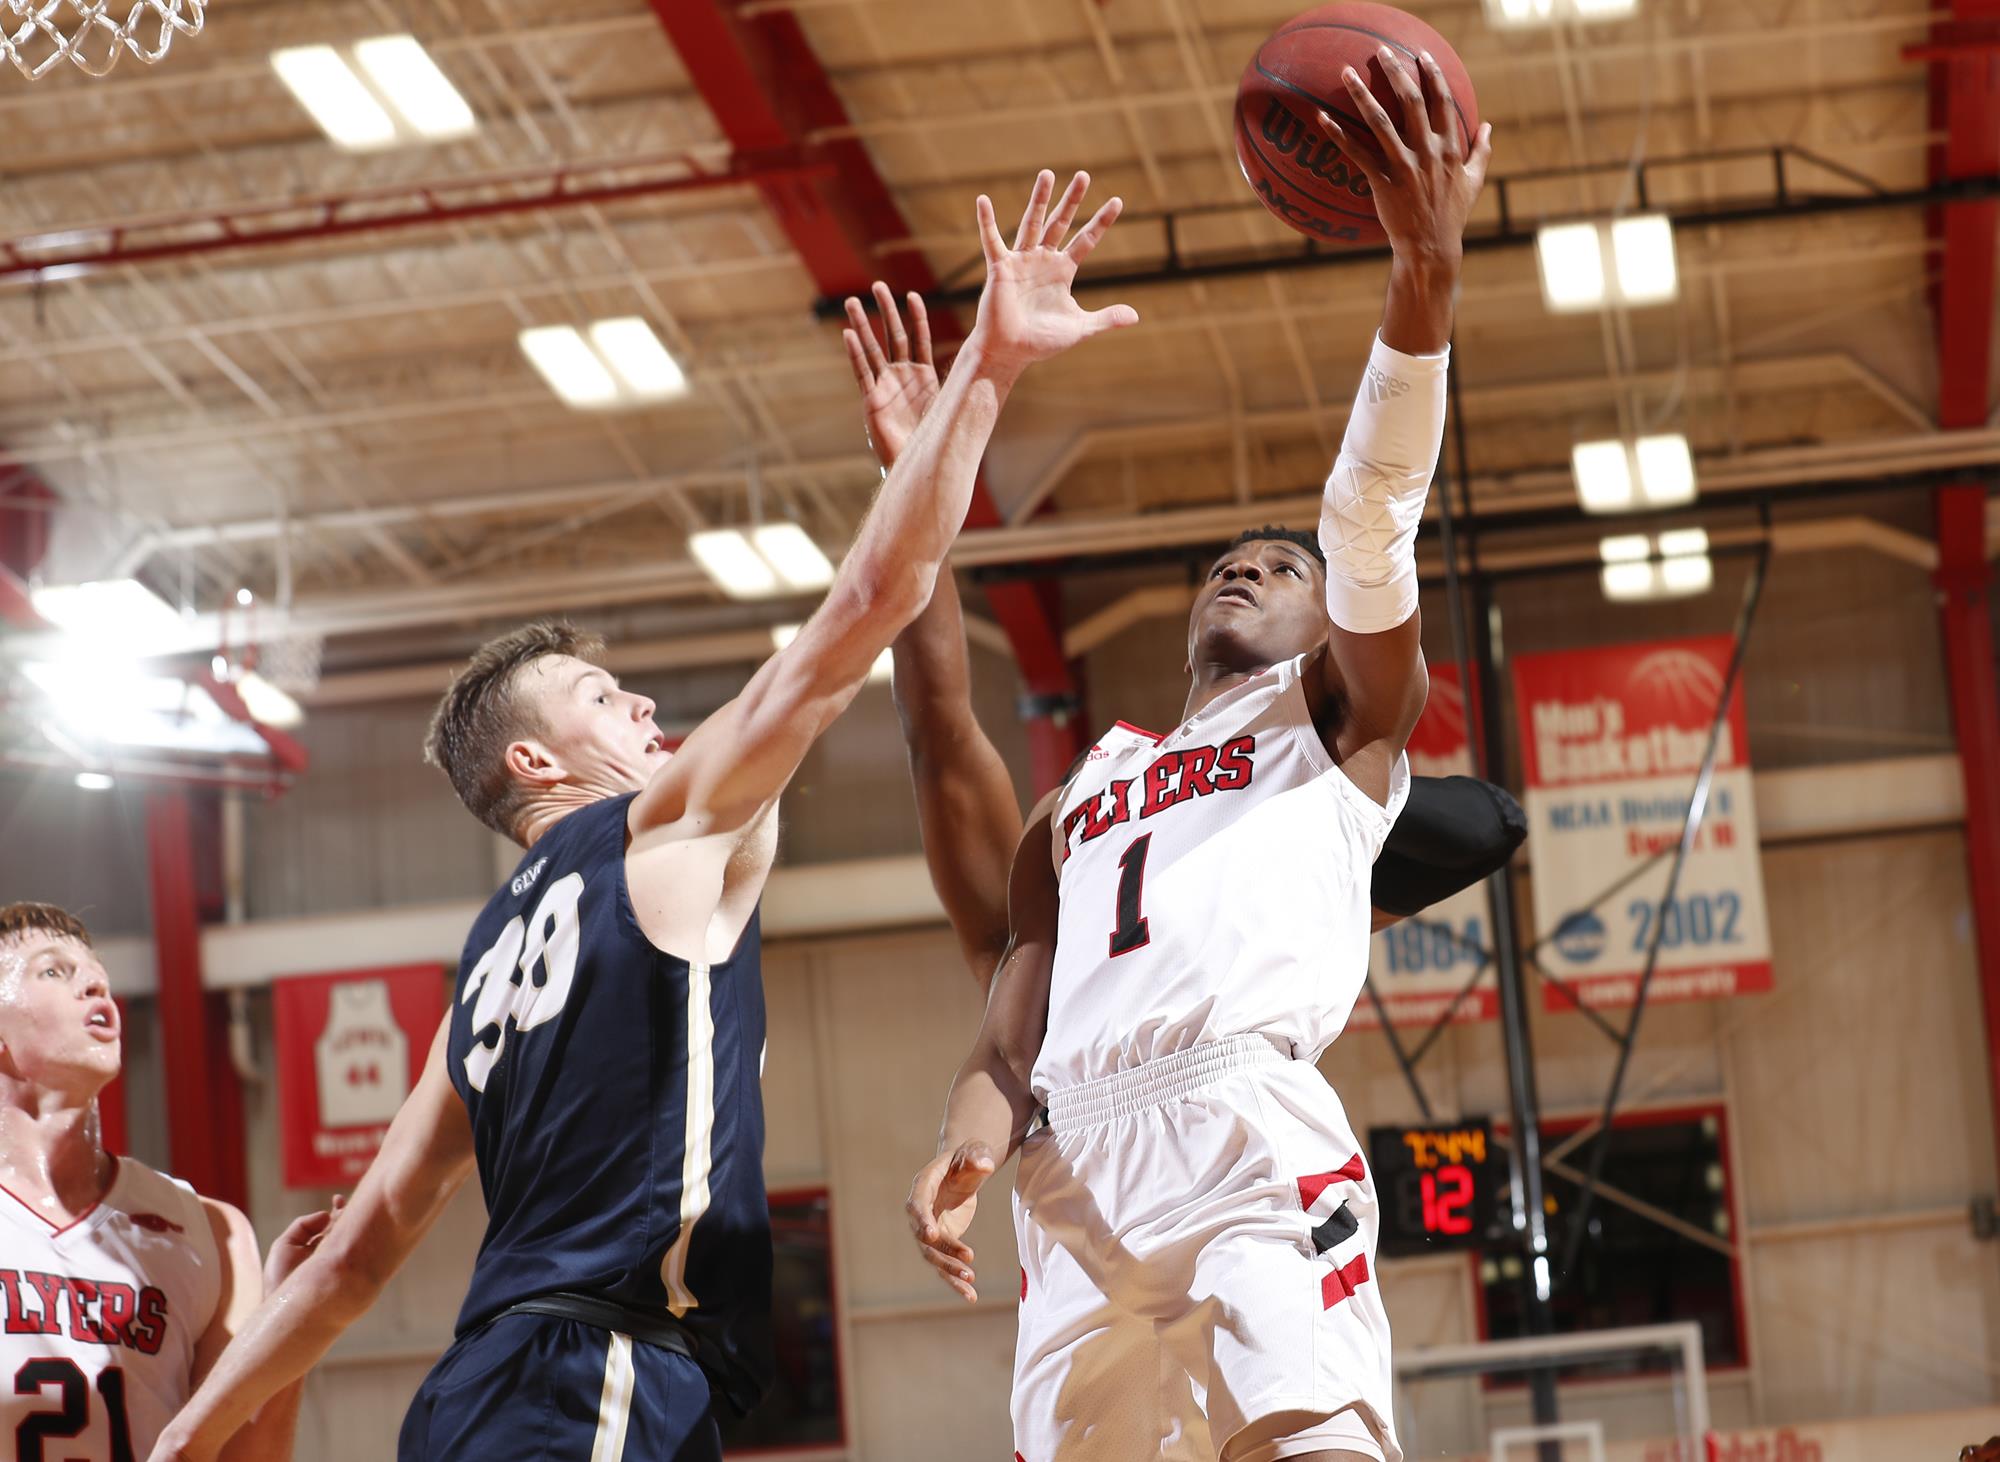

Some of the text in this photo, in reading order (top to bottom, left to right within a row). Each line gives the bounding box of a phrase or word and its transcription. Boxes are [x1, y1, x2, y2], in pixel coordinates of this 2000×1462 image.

[1262, 100, 1373, 198] Wilso
[1257, 177, 1361, 241] NCAA
[1109, 832, 1152, 958] 1
[1627, 889, 1743, 952] 2002
[461, 872, 584, 1093] 30
[1384, 916, 1488, 974] 1984
[1420, 1165, 1474, 1235] 12
[0, 1269, 167, 1356] LYERS
[14, 1357, 136, 1462] 21
